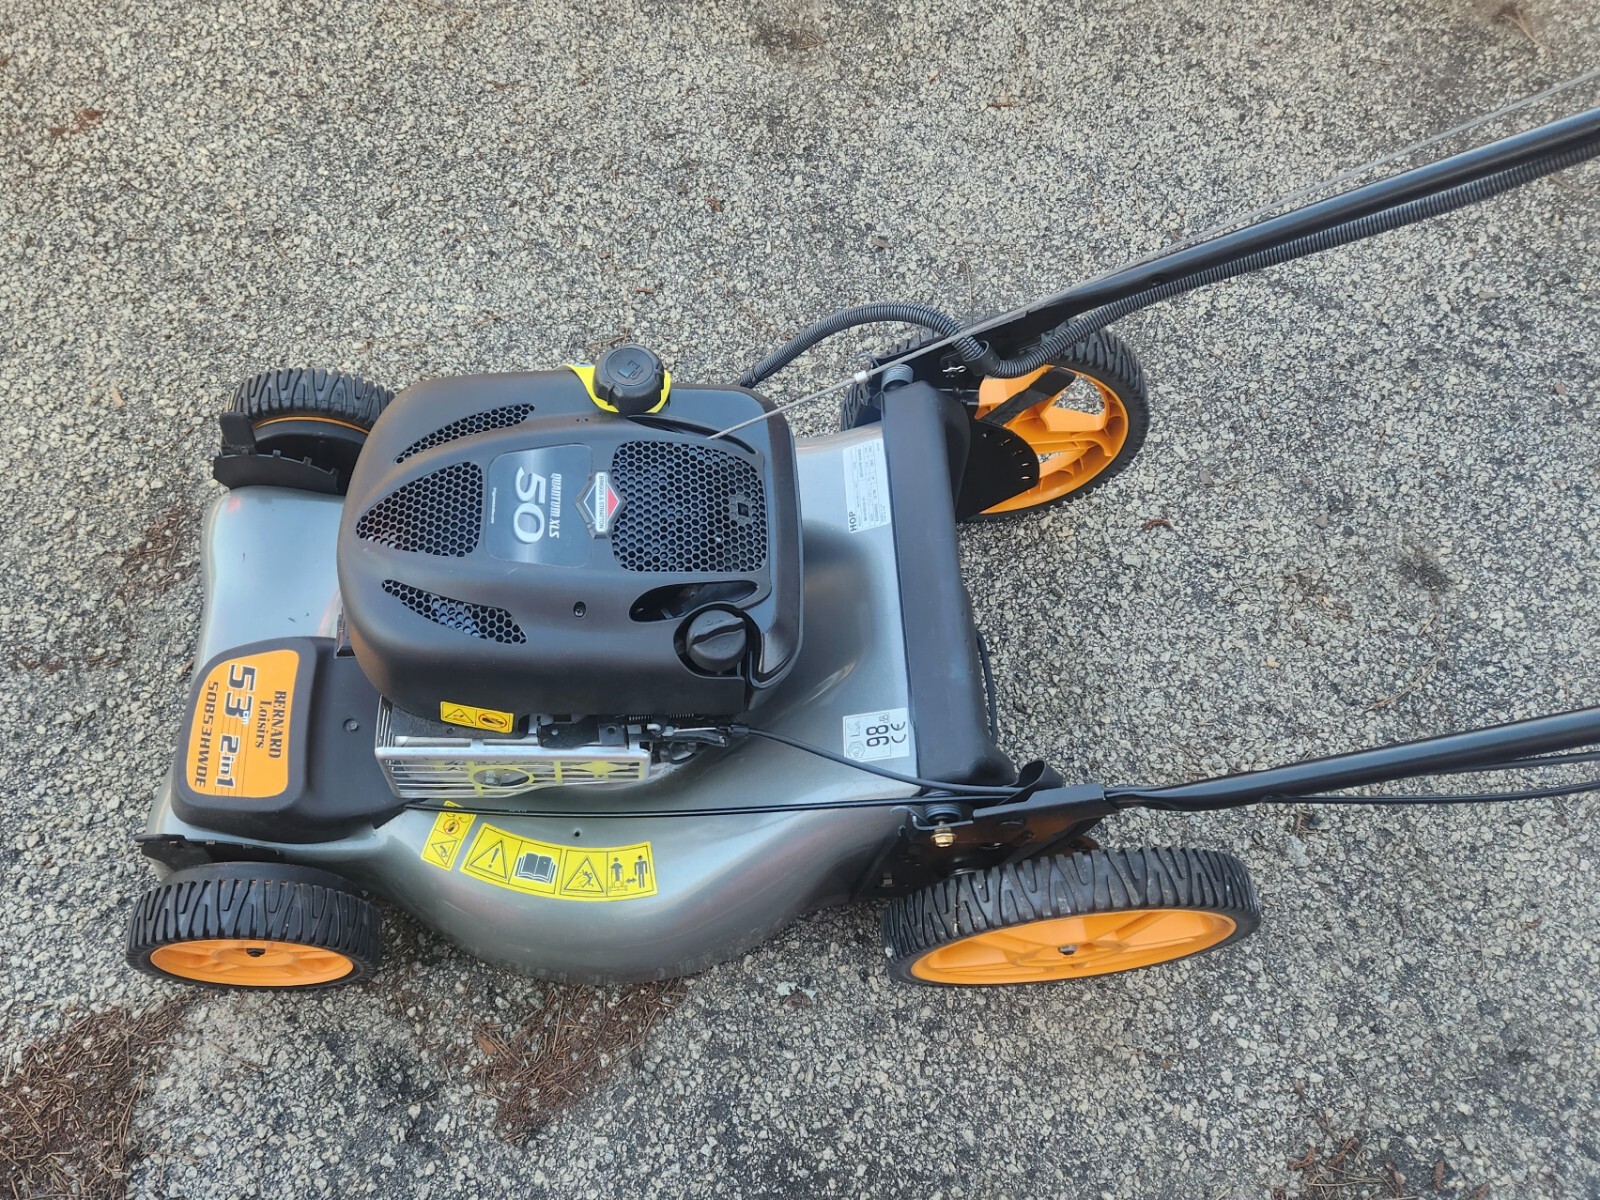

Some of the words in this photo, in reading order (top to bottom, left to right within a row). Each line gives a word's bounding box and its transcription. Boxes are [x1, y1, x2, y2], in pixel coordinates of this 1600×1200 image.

[513, 466, 546, 544] 50
[550, 473, 561, 517] QUANTUM
[549, 519, 560, 538] XLS
[848, 511, 857, 532] HOP
[224, 664, 257, 719] 53
[255, 700, 272, 749] Loisirs
[269, 690, 287, 758] BERNARD
[866, 724, 889, 748] 98
